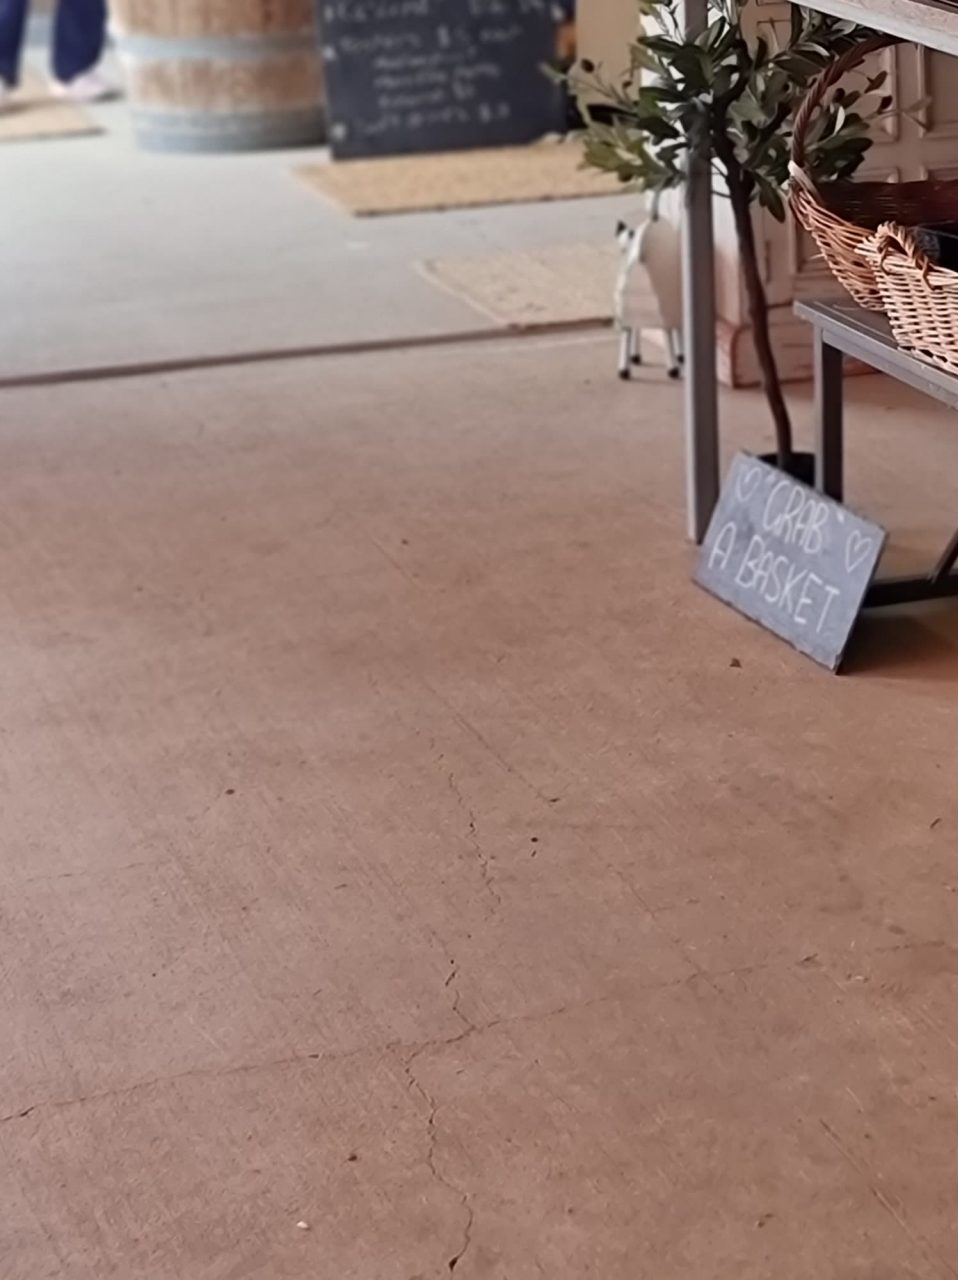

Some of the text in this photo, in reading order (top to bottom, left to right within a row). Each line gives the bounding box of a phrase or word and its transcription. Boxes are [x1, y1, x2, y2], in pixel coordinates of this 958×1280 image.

[762, 479, 830, 554] GRAB
[707, 521, 840, 634] A BASKET
